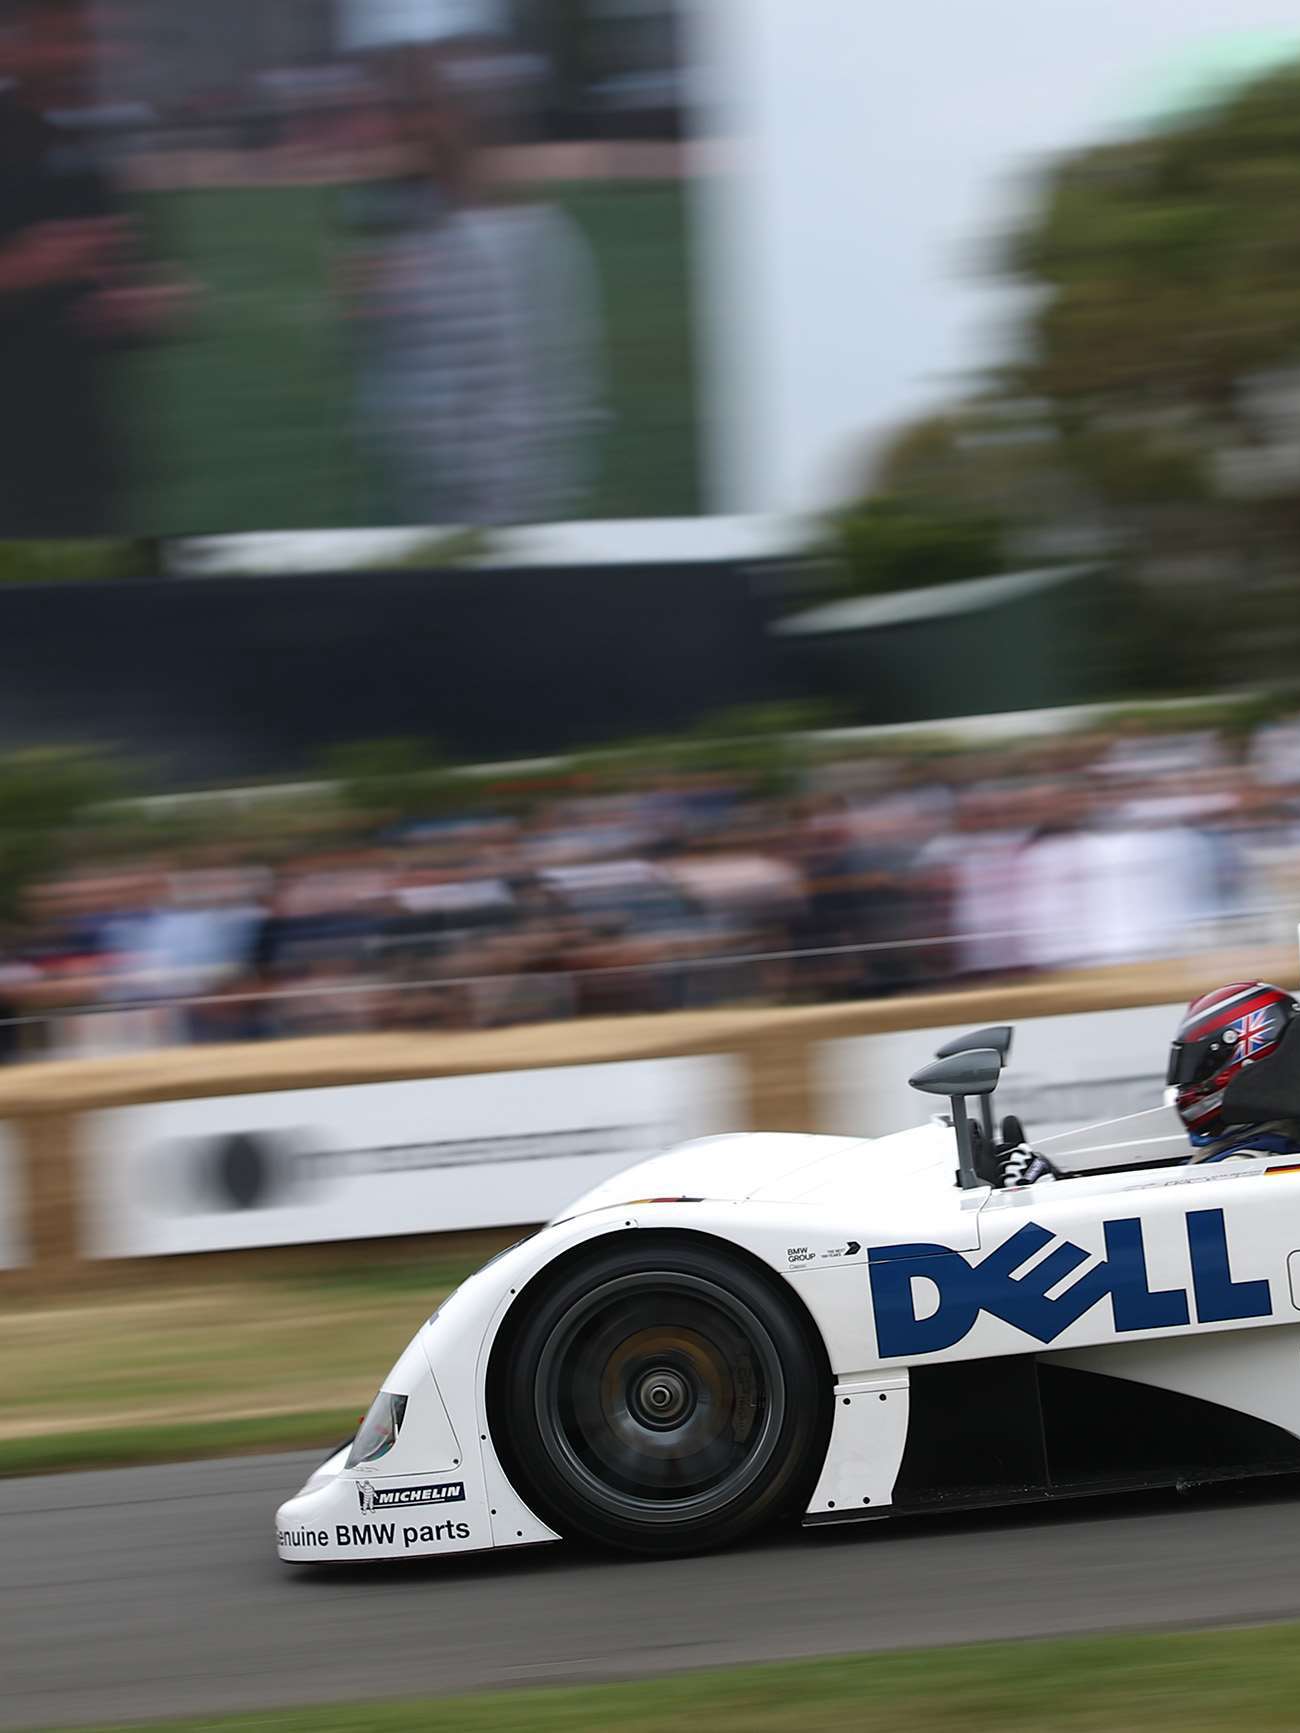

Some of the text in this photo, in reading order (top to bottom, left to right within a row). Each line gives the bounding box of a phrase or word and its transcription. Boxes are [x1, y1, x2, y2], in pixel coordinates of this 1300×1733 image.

[787, 1247, 808, 1256] BMW
[788, 1253, 816, 1263] GROUP
[866, 1207, 1273, 1359] DELL
[378, 1485, 461, 1504] MICHELIN
[278, 1519, 471, 1548] enuine BMW parts
